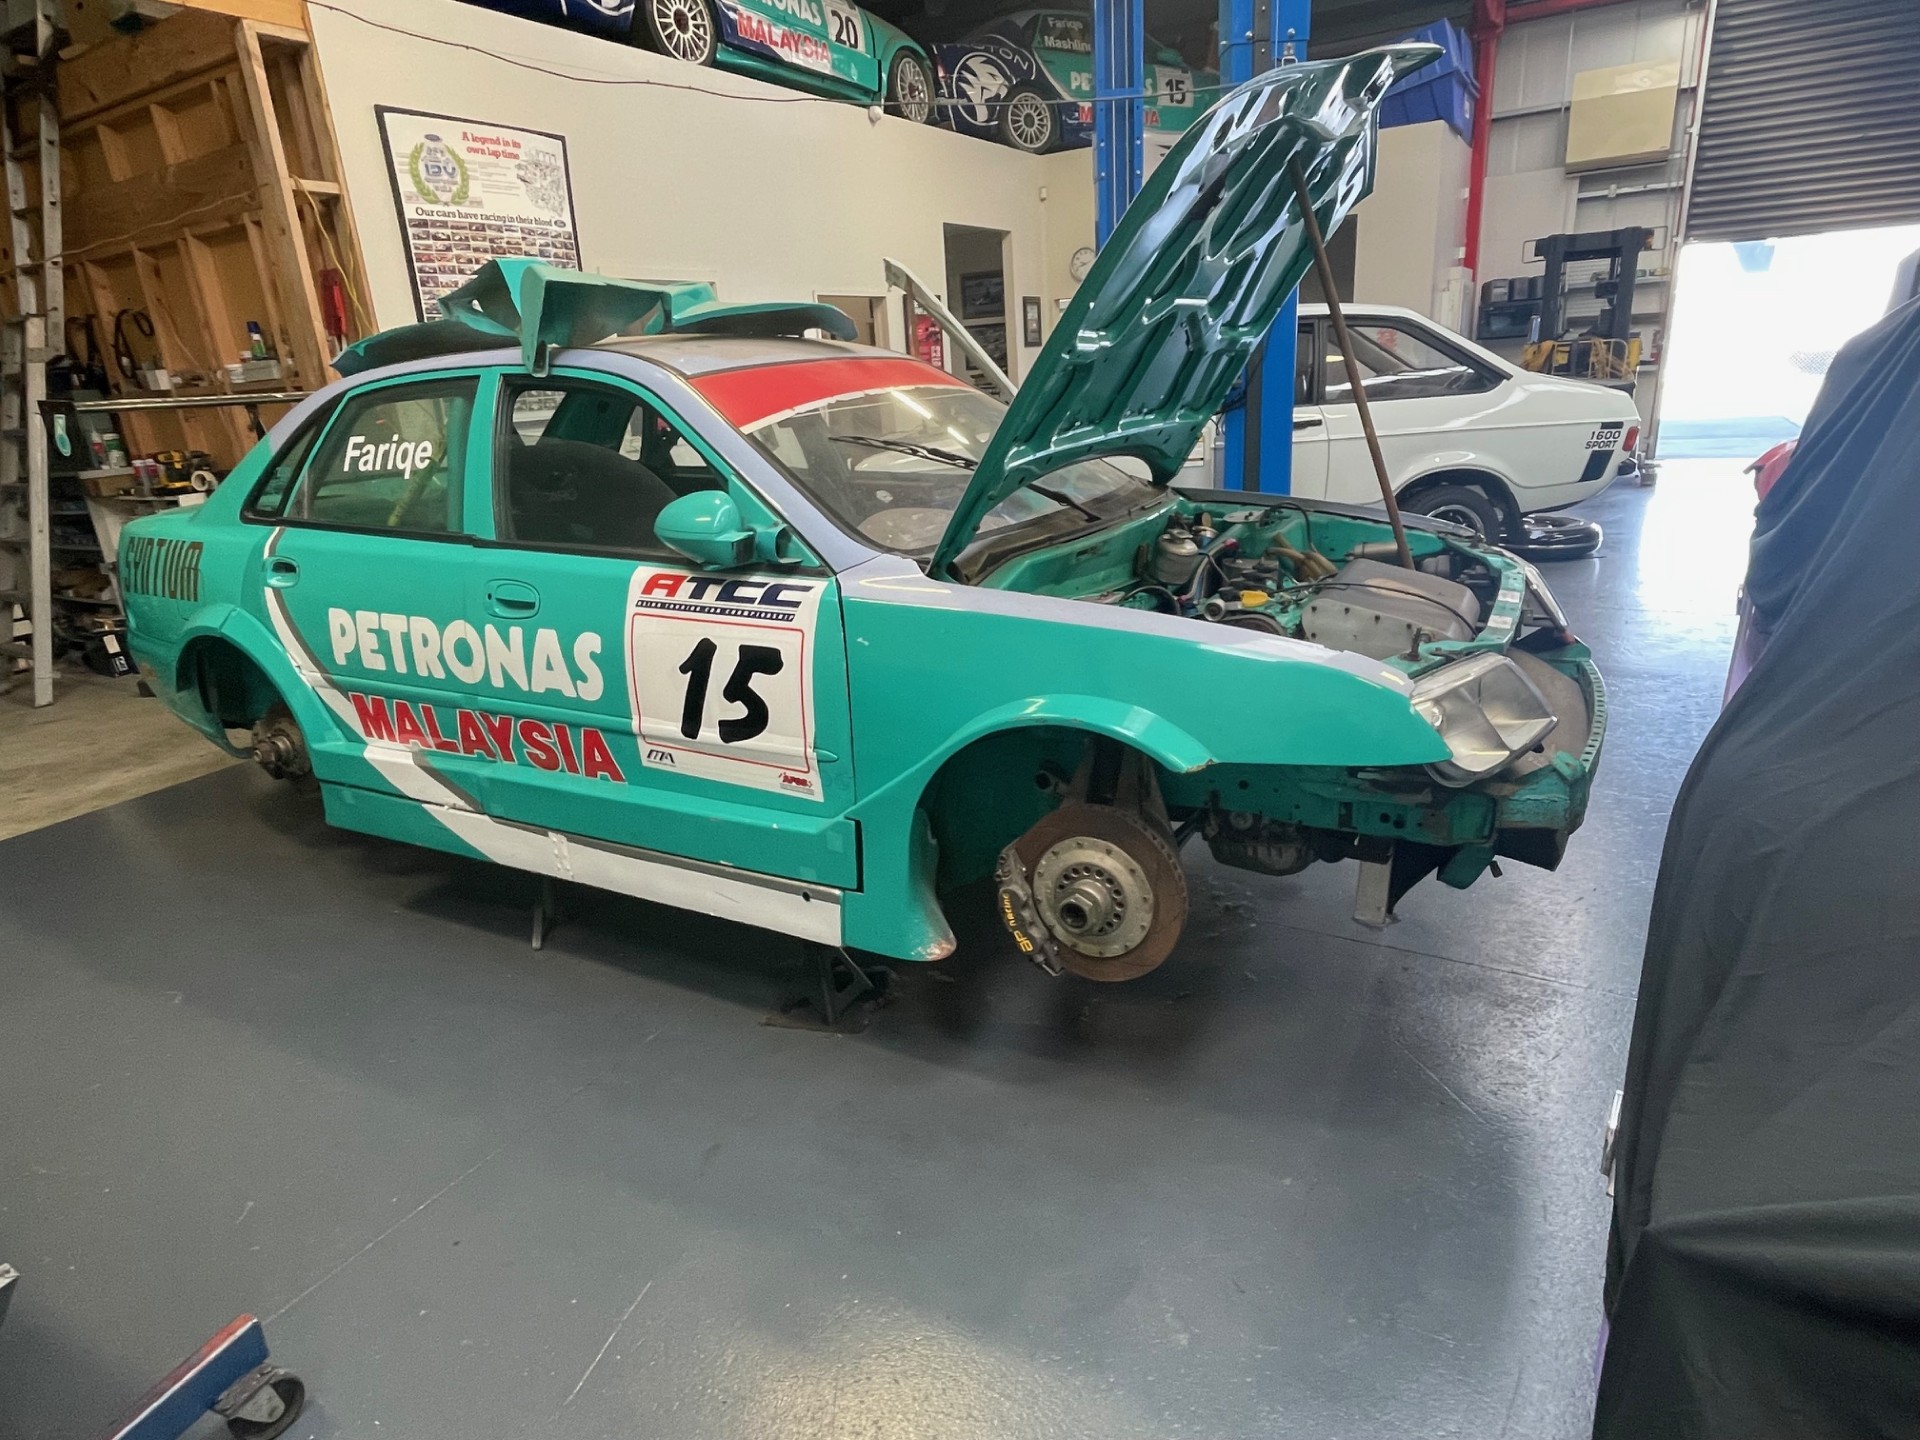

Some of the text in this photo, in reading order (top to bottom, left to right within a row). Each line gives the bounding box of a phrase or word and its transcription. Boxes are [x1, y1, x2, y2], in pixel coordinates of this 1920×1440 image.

[737, 11, 831, 61] MALAYSIA
[831, 10, 858, 49] 20
[1165, 79, 1186, 104] 15
[416, 207, 435, 217] Our
[458, 210, 478, 220] have
[480, 213, 506, 224] racing
[516, 215, 533, 225] their
[1585, 440, 1618, 449] SPORT
[1591, 431, 1621, 440] 1600
[343, 434, 433, 479] Fariqe
[641, 573, 814, 608] ATCC
[328, 608, 604, 701] PETRONAS
[679, 638, 784, 744] 15
[348, 692, 627, 784] MALAYSIA
